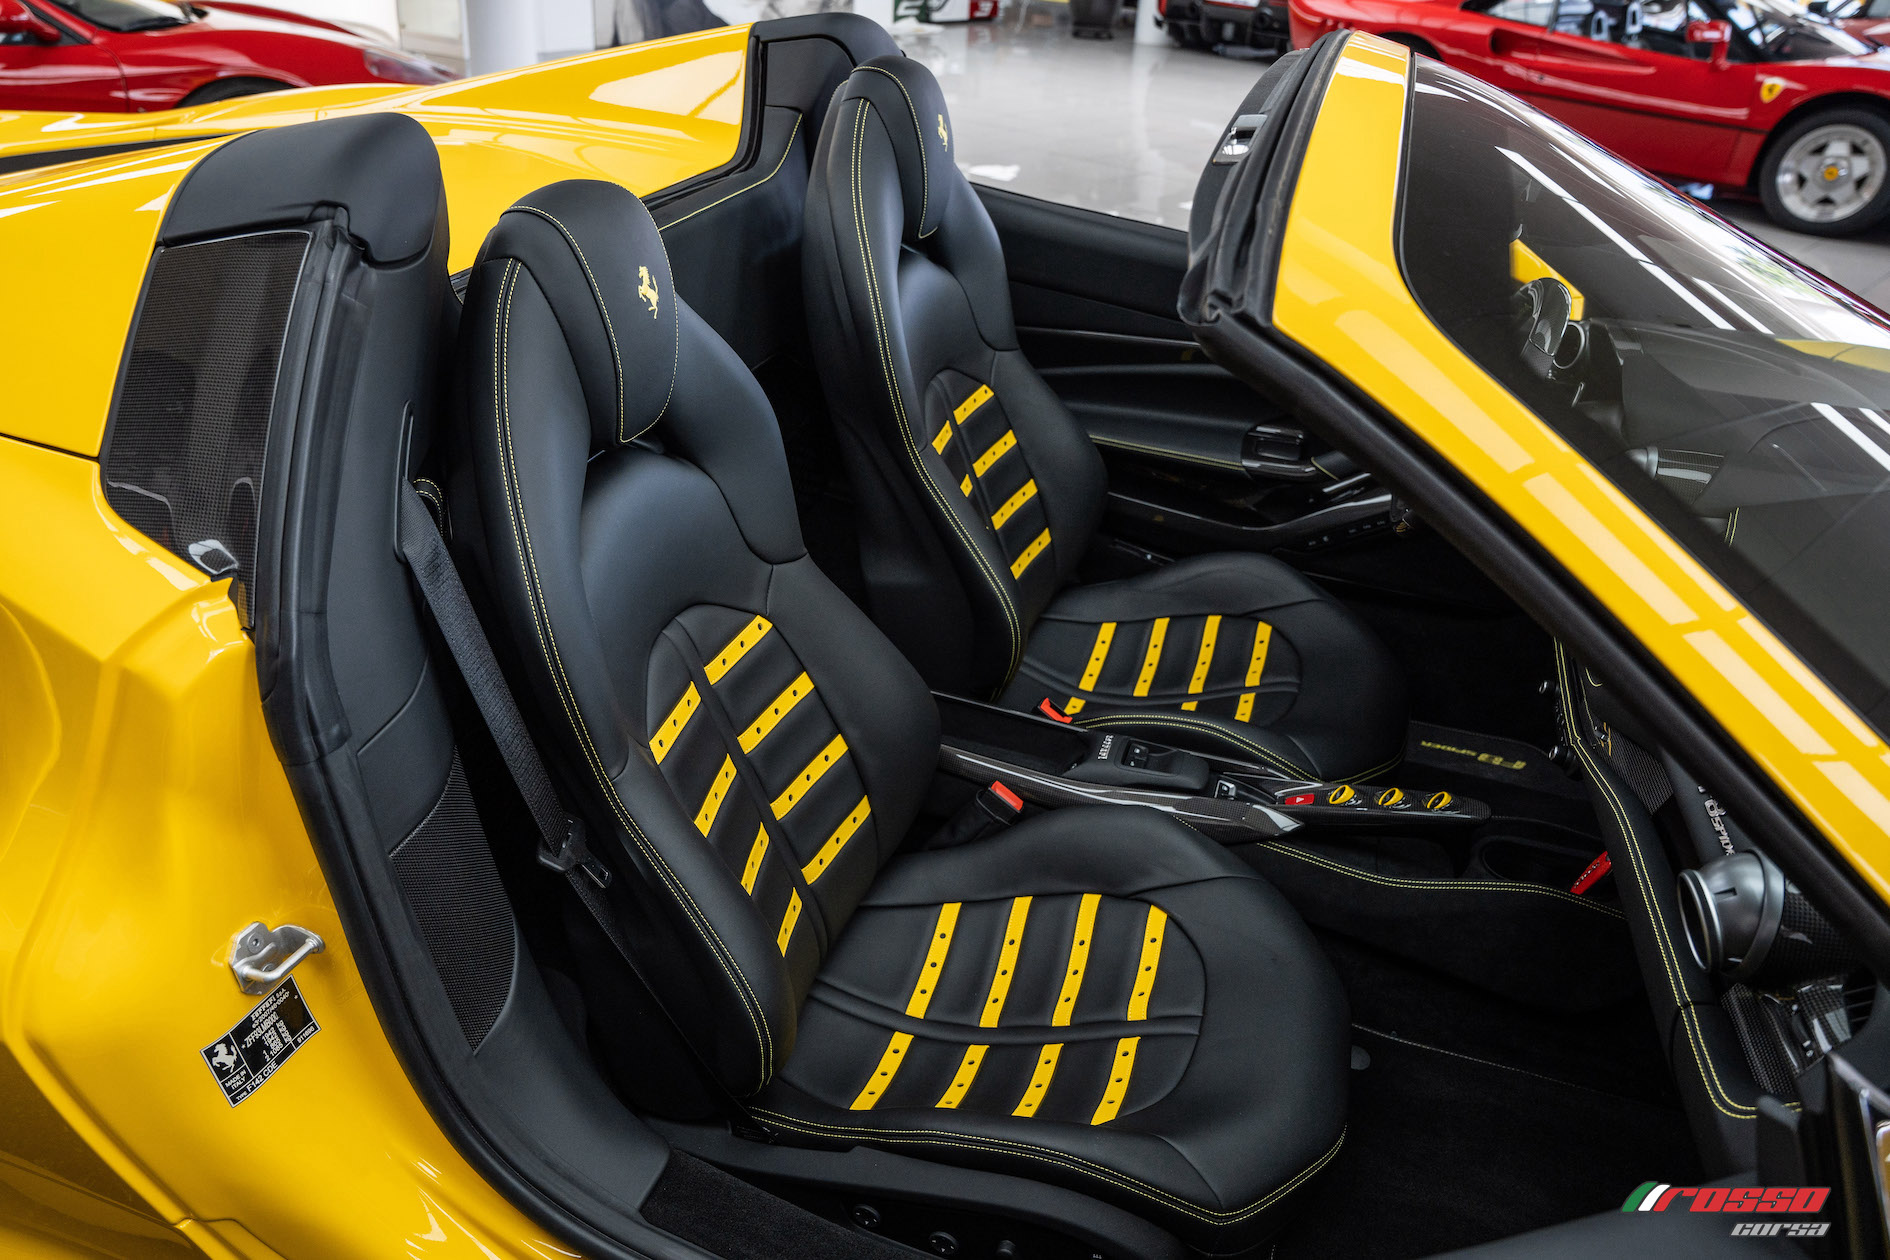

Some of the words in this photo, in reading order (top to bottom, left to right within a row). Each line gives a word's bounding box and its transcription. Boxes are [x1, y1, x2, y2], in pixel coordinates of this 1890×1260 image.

[251, 995, 277, 1021] Ferrari
[225, 1074, 241, 1087] MADE
[240, 1069, 247, 1077] IN
[231, 1076, 246, 1090] ITALY
[235, 1091, 248, 1100] TYPE
[246, 1075, 264, 1092] F142
[263, 1060, 278, 1077] CDE
